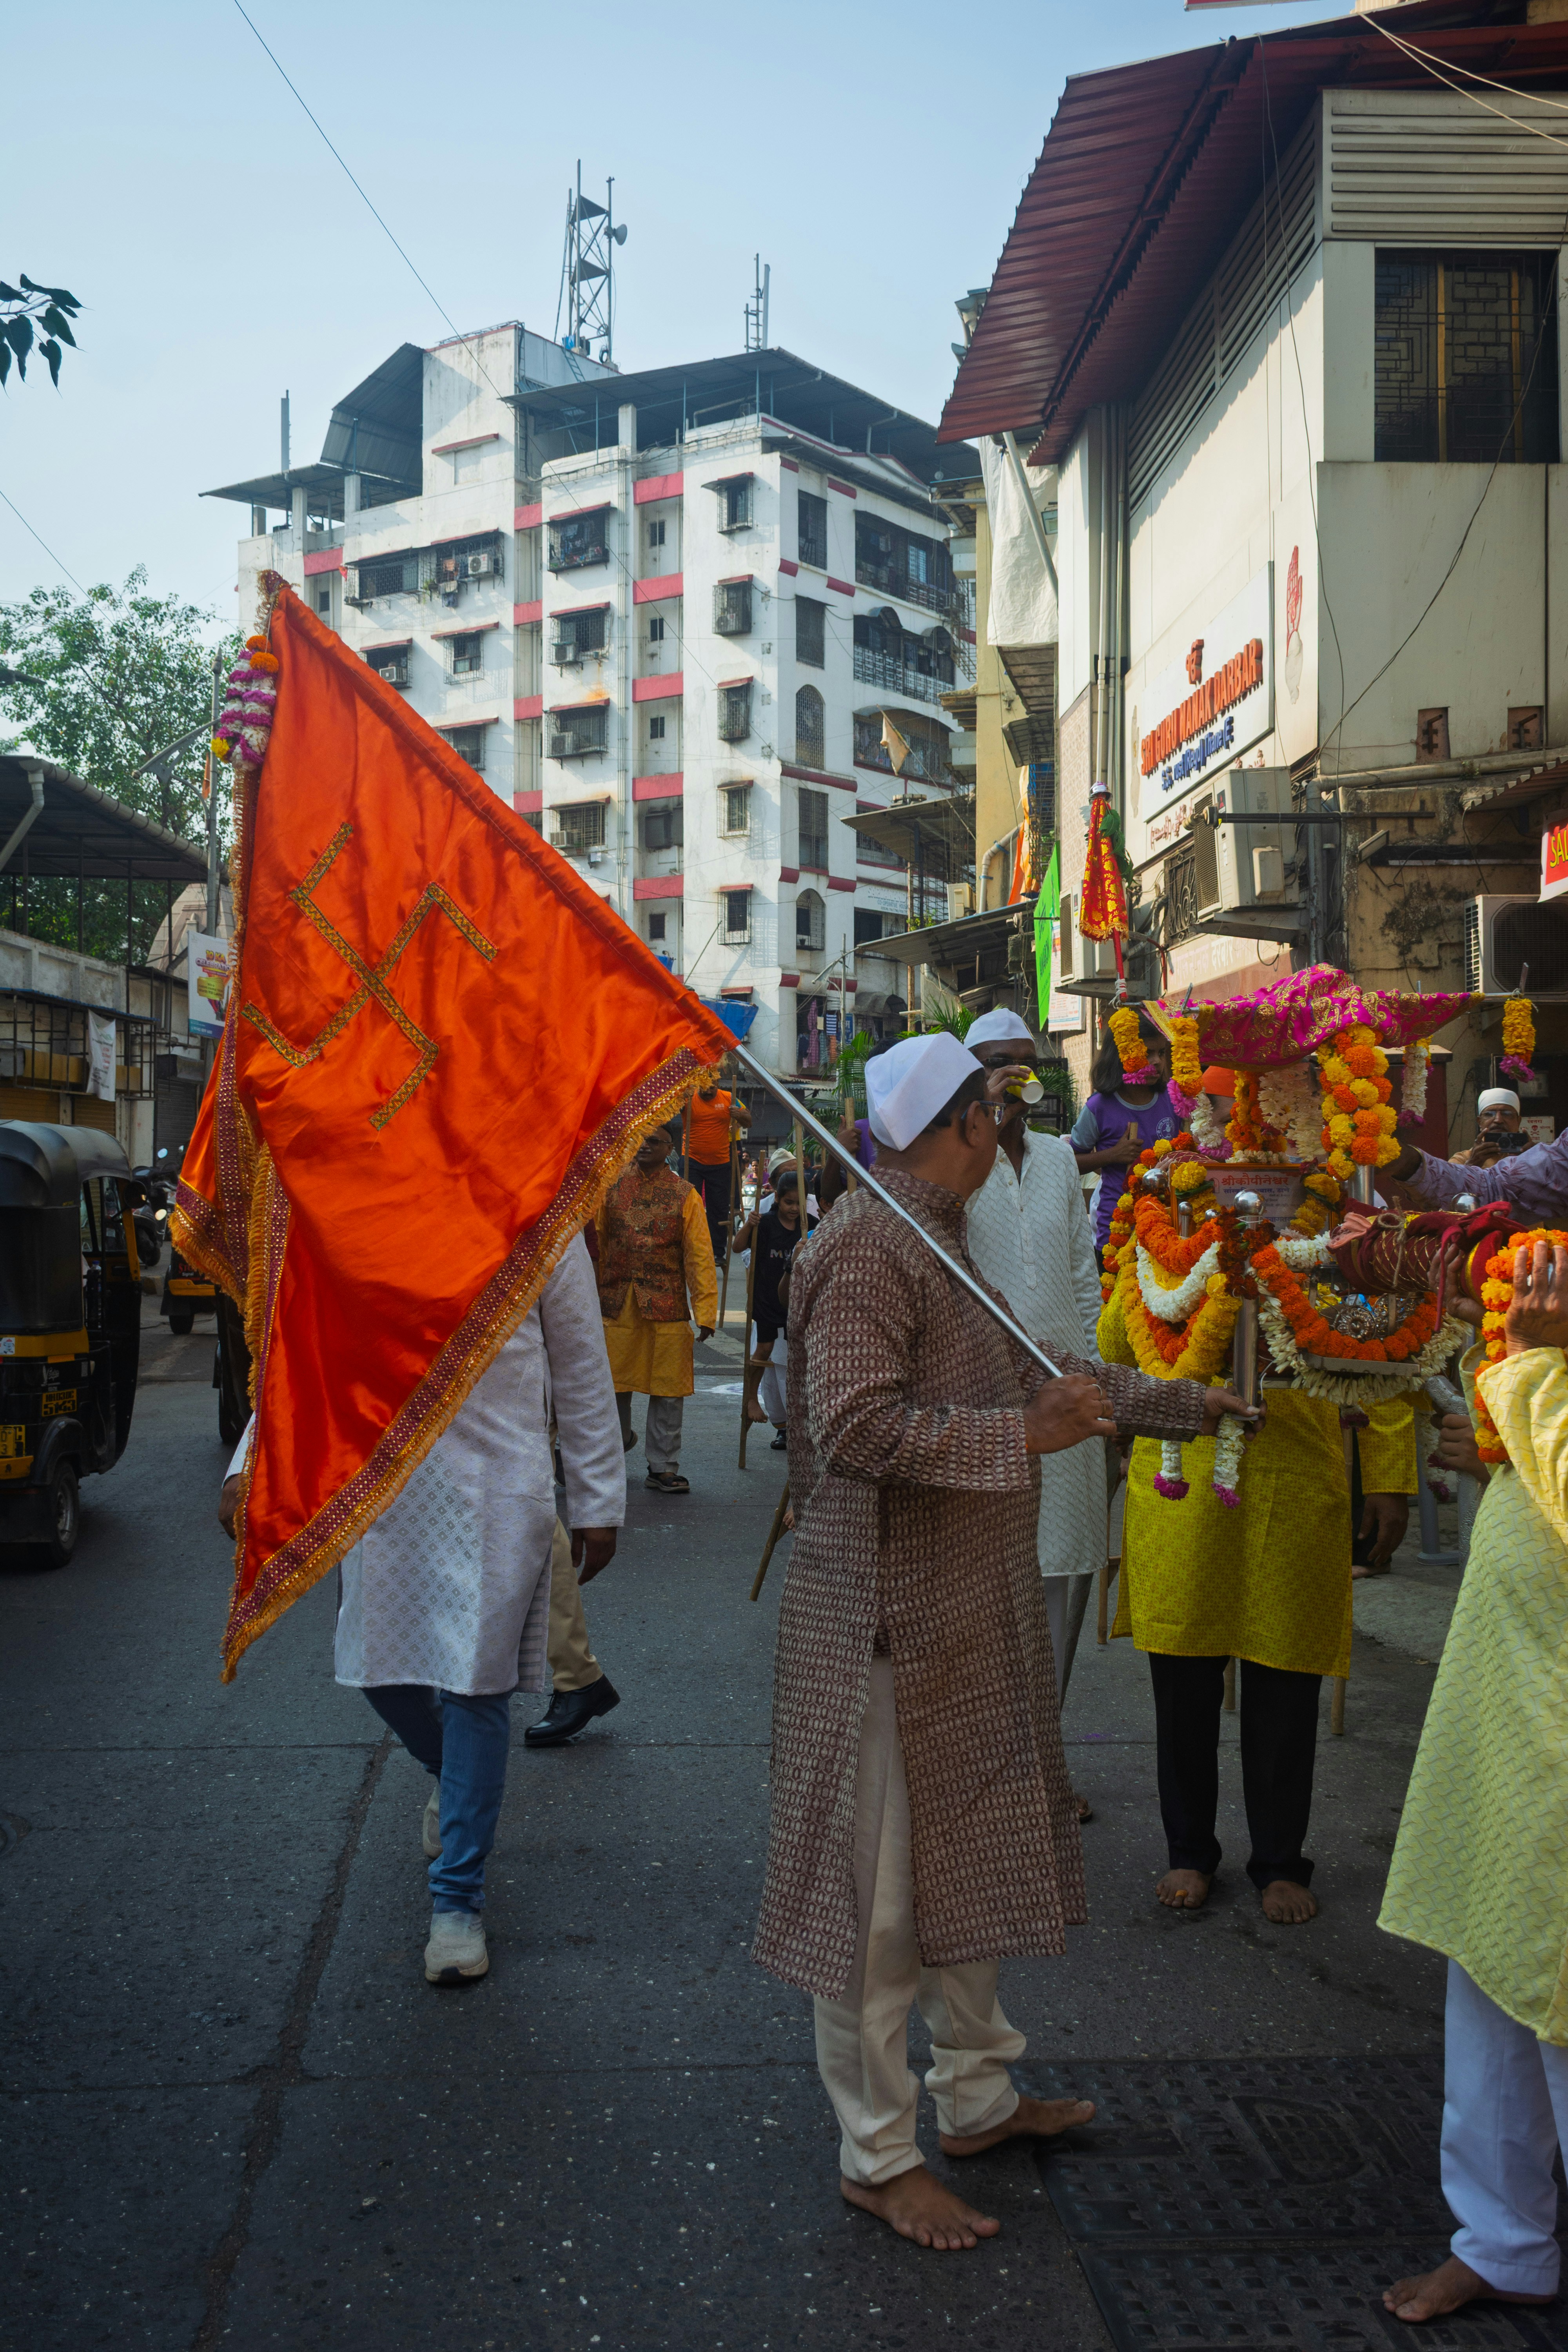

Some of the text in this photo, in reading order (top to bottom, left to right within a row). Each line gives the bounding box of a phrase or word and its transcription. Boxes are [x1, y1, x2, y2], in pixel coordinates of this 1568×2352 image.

[1141, 638, 1263, 776] SRI GURU NANAK DARBAR
[1205, 730, 1224, 757] Thane
[196, 958, 231, 971] CELEBRATIO
[206, 950, 226, 964] 10 KA
